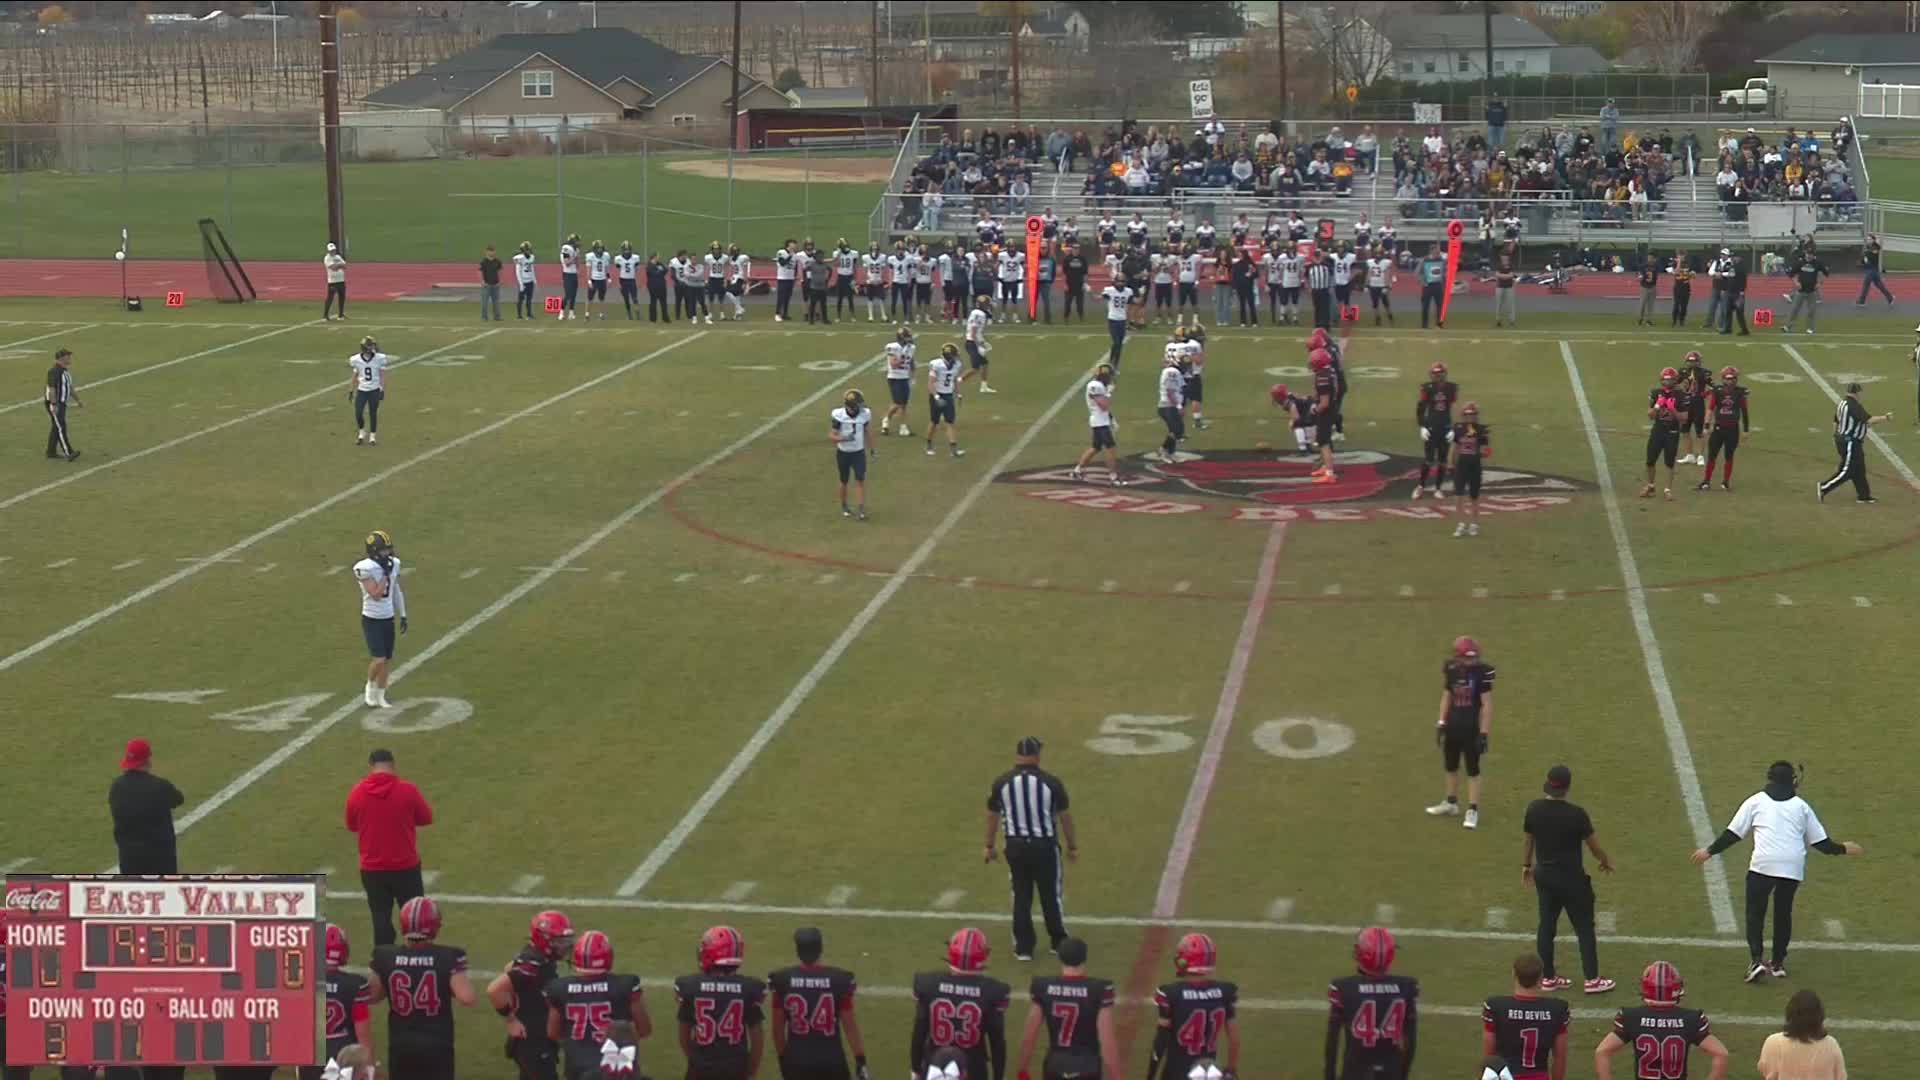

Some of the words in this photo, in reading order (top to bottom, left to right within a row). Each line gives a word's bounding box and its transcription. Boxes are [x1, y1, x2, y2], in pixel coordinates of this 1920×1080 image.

[1321, 222, 1334, 238] 3
[167, 293, 183, 306] 20
[546, 299, 559, 310] 30
[364, 367, 373, 382] 9
[1021, 487, 1205, 514] RED
[84, 885, 165, 915] EAST
[178, 885, 304, 915] VALLEY
[8, 925, 66, 946] HOME
[250, 925, 311, 947] GUEST
[284, 950, 304, 986] 0
[395, 955, 408, 966] RED
[409, 955, 434, 967] DEVILS
[389, 970, 440, 1016] 64
[29, 997, 84, 1019] DOWN
[91, 998, 115, 1018] TO
[120, 998, 145, 1018] GO
[169, 998, 208, 1018] BALL
[211, 998, 234, 1018] ON
[244, 998, 279, 1019] QTR
[566, 1001, 612, 1042] 75
[694, 998, 745, 1045] 54
[784, 993, 836, 1036] 34
[1508, 1009, 1523, 1020] RED
[1525, 1009, 1552, 1021] DEVILS
[930, 999, 982, 1048] 63
[1052, 1002, 1079, 1048] 7
[1177, 1008, 1226, 1054] 41
[1351, 999, 1406, 1047] 44
[1641, 1017, 1656, 1028] RED
[1658, 1017, 1684, 1029] DEVILS
[47, 1023, 65, 1059] 3
[1520, 1028, 1539, 1068] 1
[1635, 1034, 1687, 1080] 20
